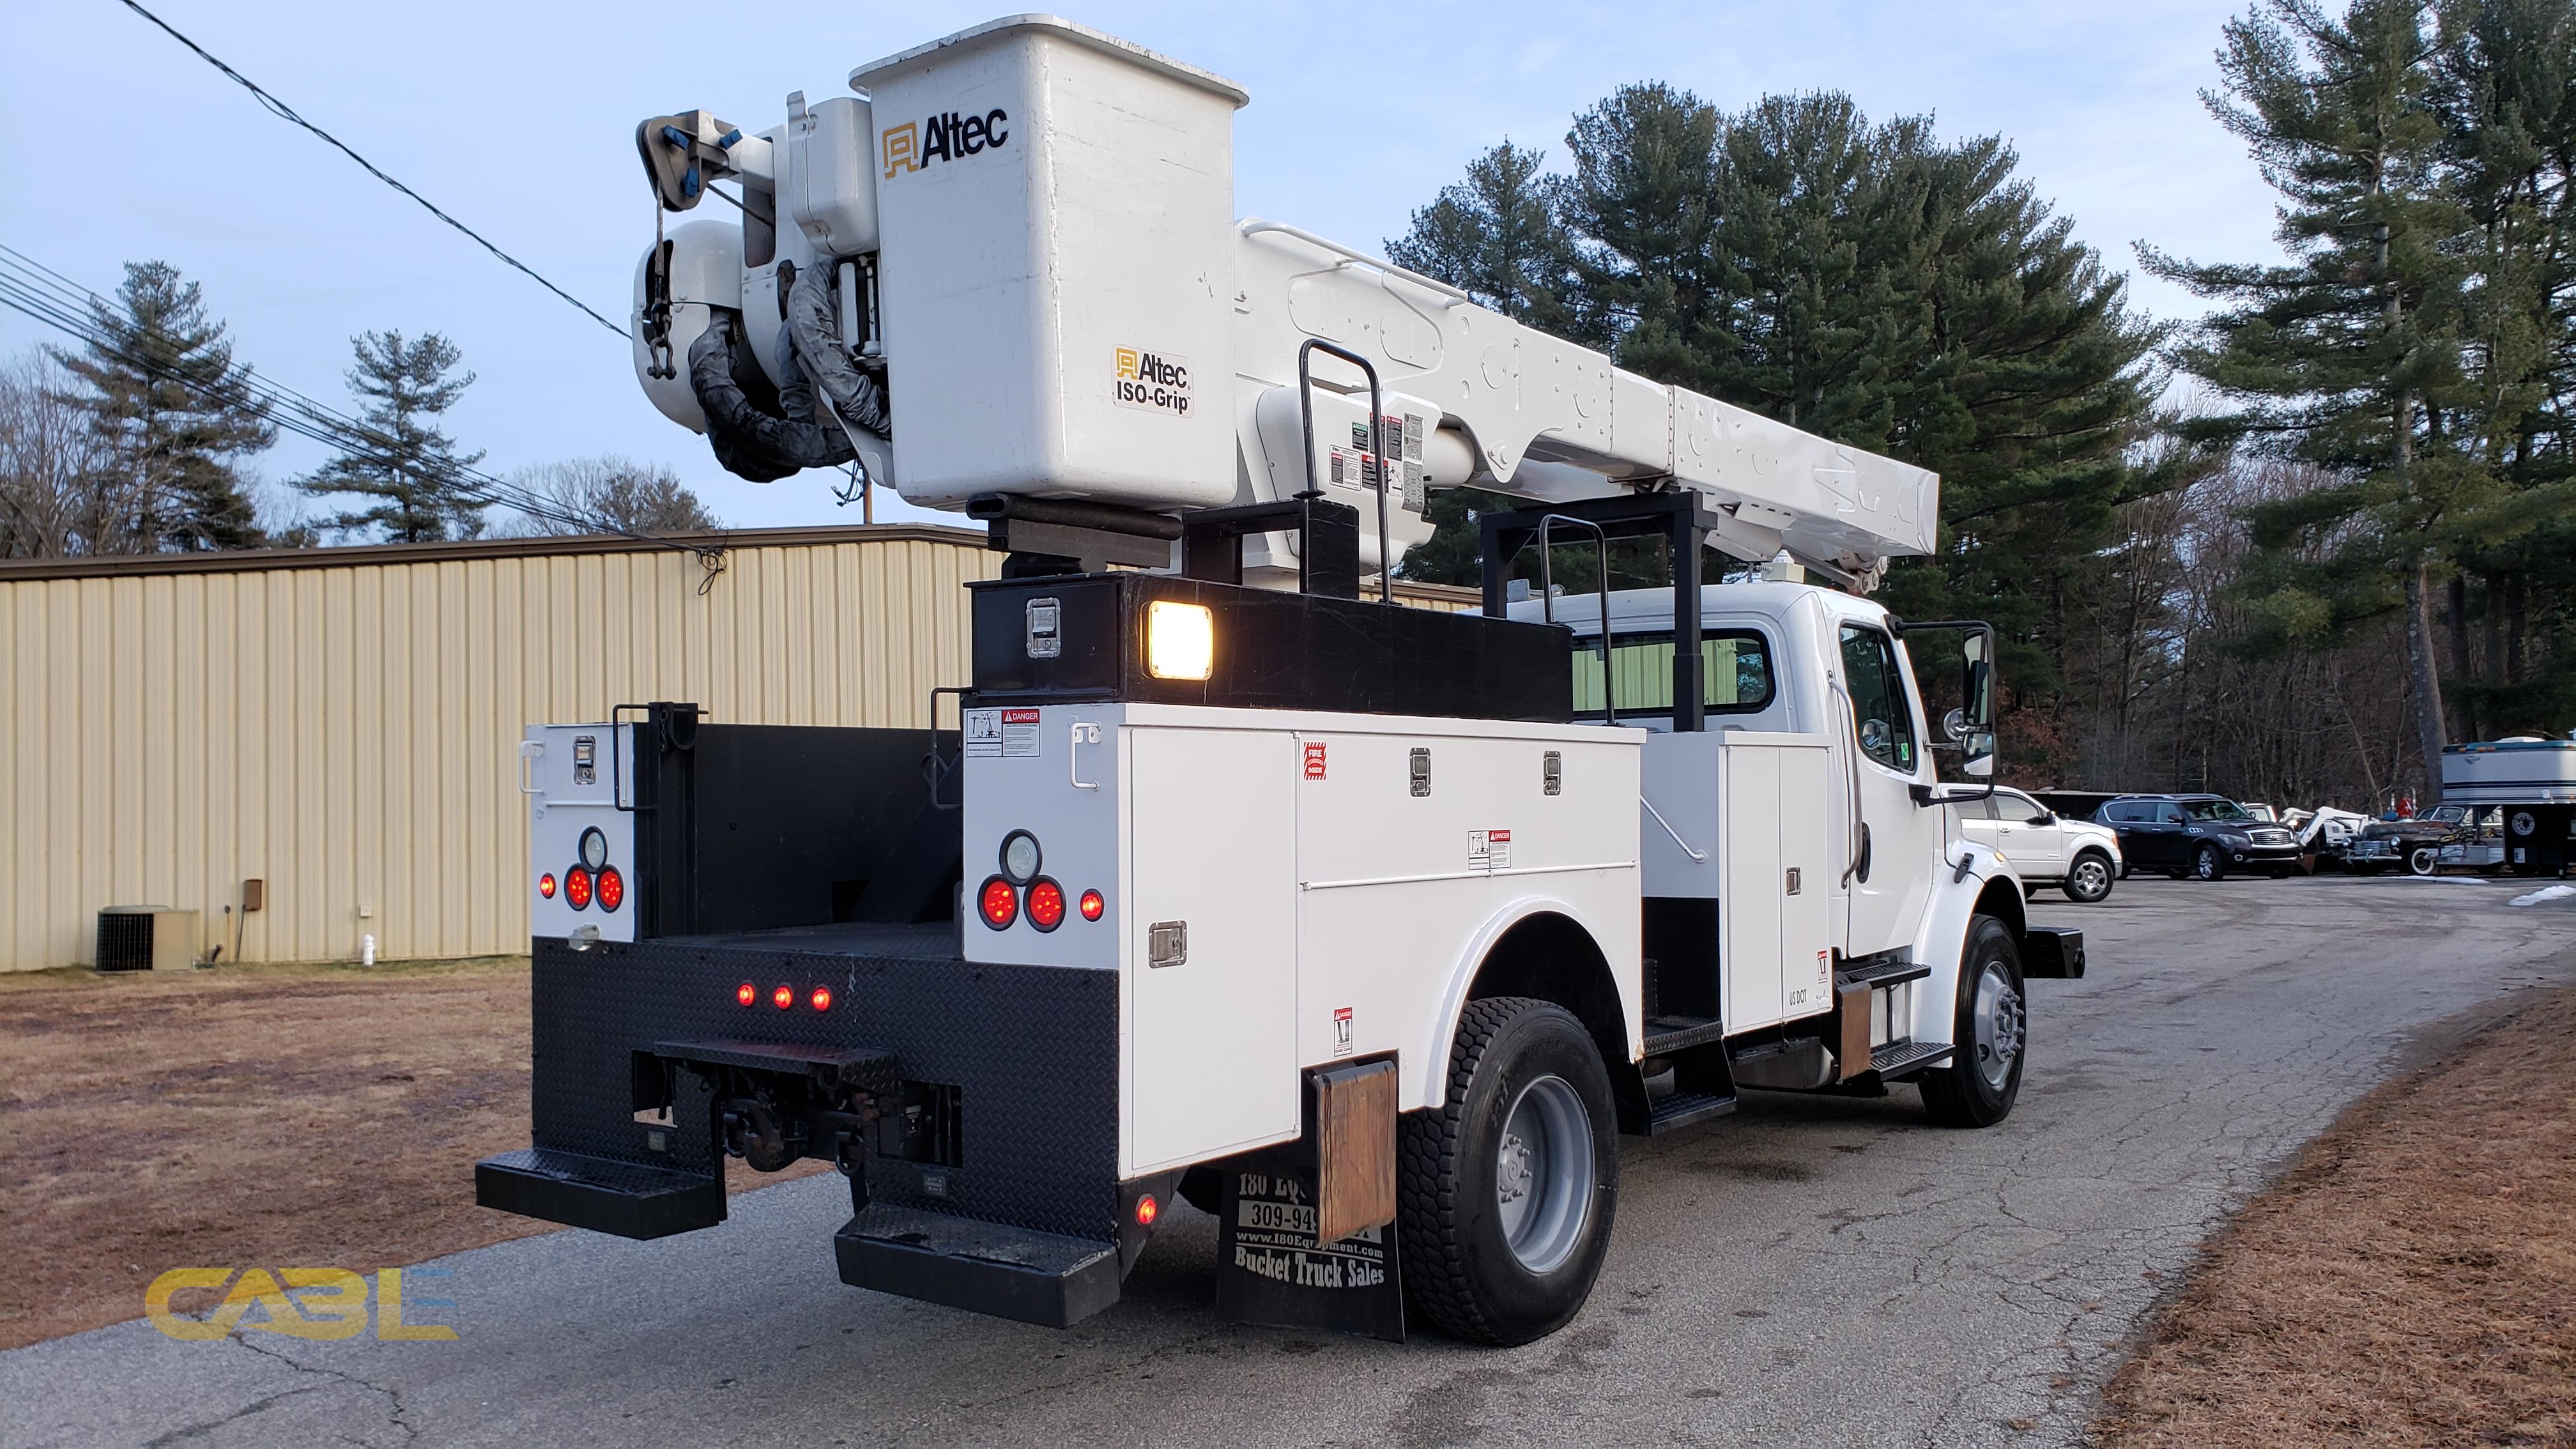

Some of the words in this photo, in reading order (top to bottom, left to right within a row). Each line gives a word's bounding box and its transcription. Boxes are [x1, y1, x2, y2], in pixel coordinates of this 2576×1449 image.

[921, 109, 1008, 169] Altec
[1138, 353, 1187, 388] Altec
[1117, 381, 1188, 415] ISO-Grip
[1790, 991, 1796, 1006] US
[1797, 989, 1807, 1004] DOT
[1234, 1246, 1291, 1282] Bucket
[1295, 1252, 1342, 1287] Truck
[1347, 1259, 1384, 1287] Sales
